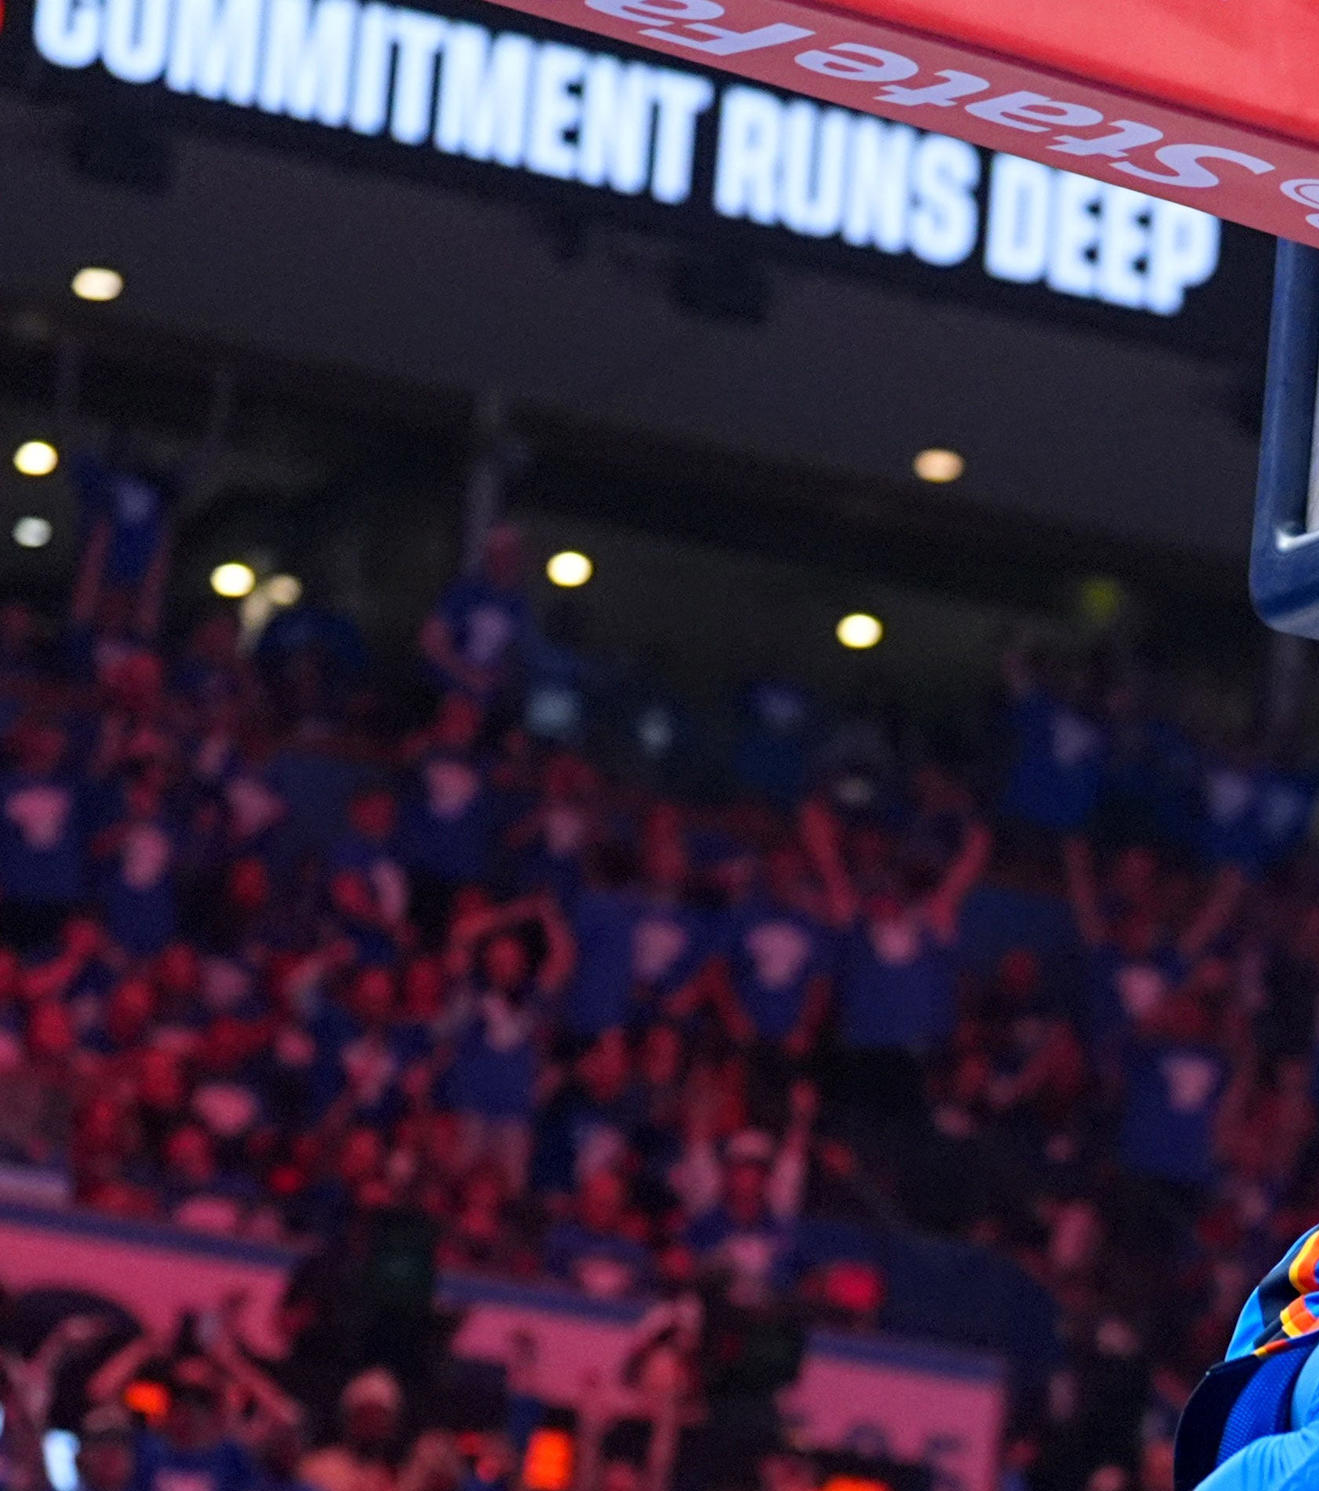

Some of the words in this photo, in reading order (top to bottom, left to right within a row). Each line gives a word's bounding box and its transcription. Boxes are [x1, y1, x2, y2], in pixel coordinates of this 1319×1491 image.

[33, 0, 714, 206] COMMITMENT
[713, 83, 981, 266] RUNS
[984, 150, 1222, 316] DEEP
[794, 42, 1276, 188] State
